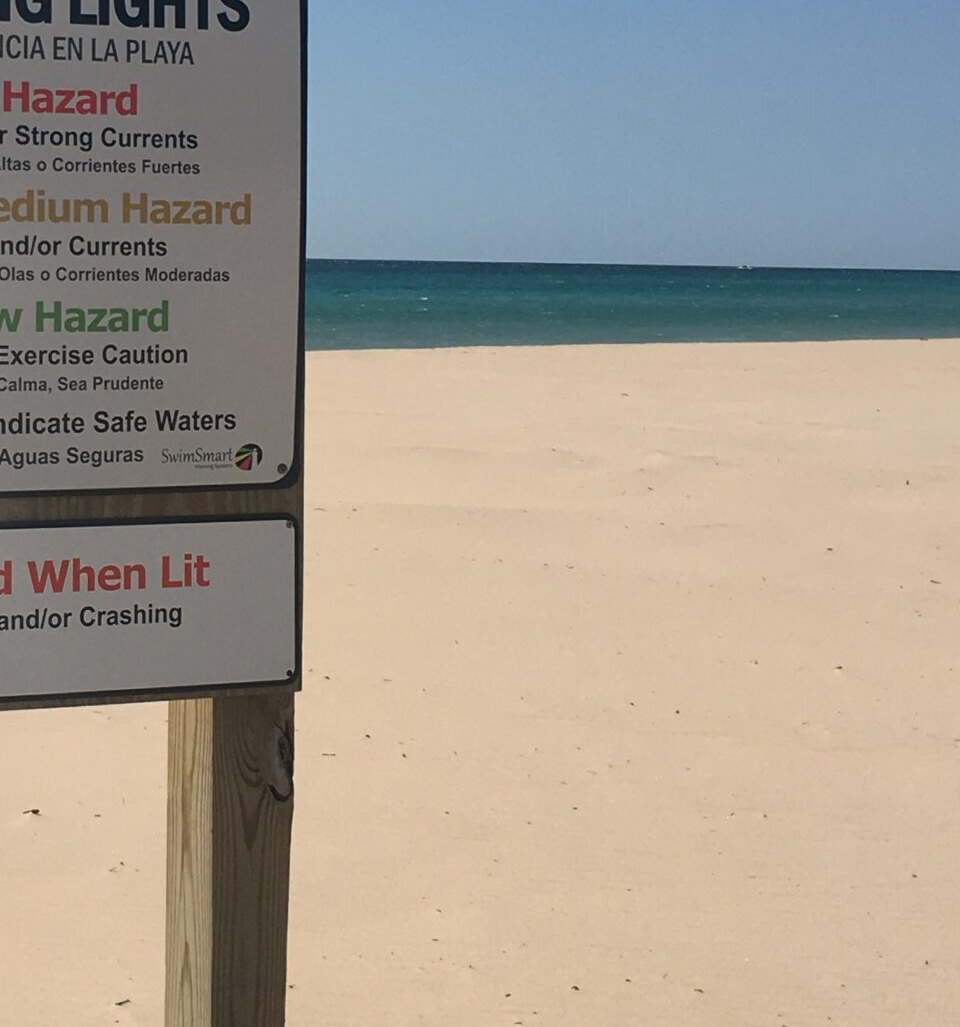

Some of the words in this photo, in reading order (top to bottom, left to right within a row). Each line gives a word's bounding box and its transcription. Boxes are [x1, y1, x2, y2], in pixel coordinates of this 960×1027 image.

[53, 37, 82, 61] EN
[92, 38, 118, 62] LA
[127, 39, 194, 65] PLAYA
[3, 81, 137, 116] Hazard
[16, 125, 92, 152] Strong
[101, 127, 198, 149] Currents
[36, 160, 47, 172] o
[52, 158, 136, 173] Corrientes
[142, 159, 200, 174] Fuertes
[123, 193, 251, 225] Hazard
[69, 236, 167, 256] Currents
[40, 269, 51, 282] o
[56, 267, 139, 281] Corrientes
[145, 268, 229, 282] Moderadas
[36, 300, 168, 333] Hazard
[103, 344, 187, 364] Caution
[58, 377, 87, 391] Sea
[93, 376, 163, 390] Prudente
[94, 410, 147, 433] Safe
[155, 410, 236, 431] Waters
[67, 447, 143, 467] Seguras
[161, 447, 233, 464] SwimSmart
[27, 558, 146, 593] When
[162, 554, 210, 588] Lit
[80, 604, 181, 627] Crashing
